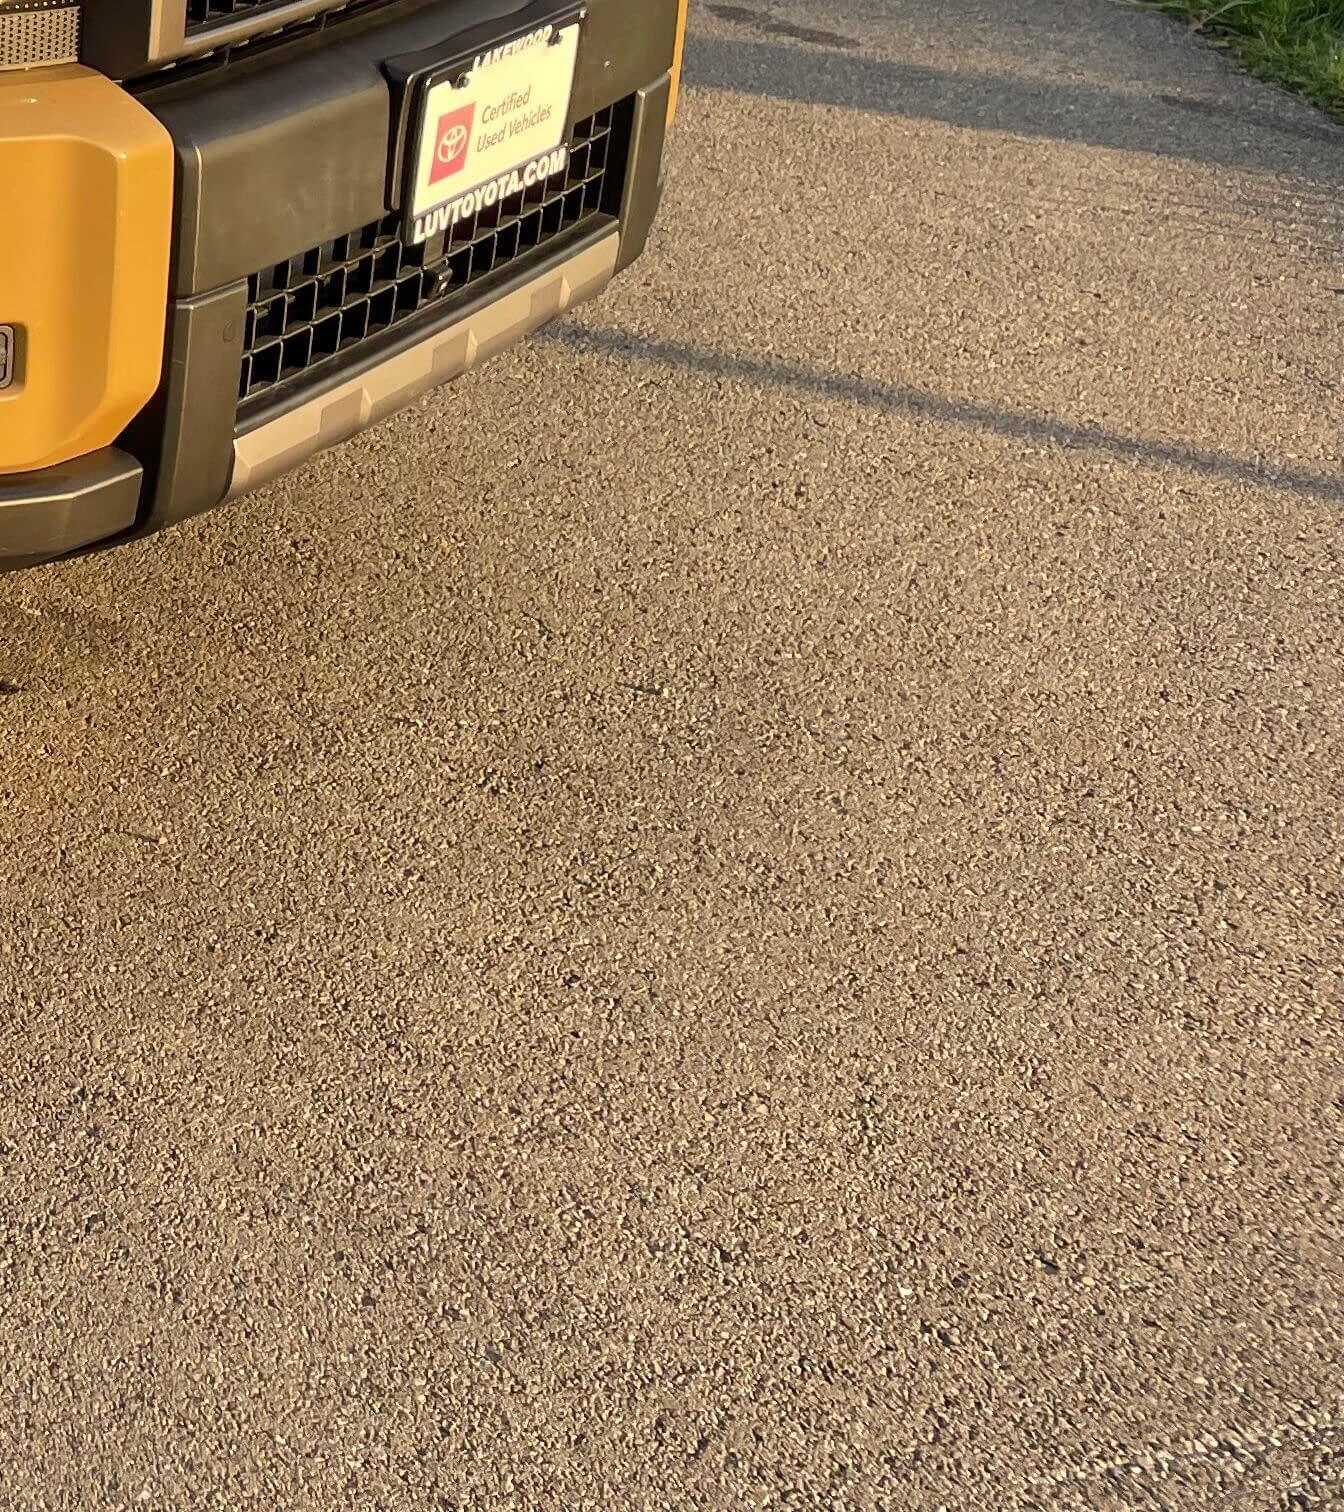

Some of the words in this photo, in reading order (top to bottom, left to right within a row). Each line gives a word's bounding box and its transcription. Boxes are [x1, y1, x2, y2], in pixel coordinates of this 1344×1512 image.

[476, 128, 507, 153] Used
[508, 103, 552, 138] Vehicles
[481, 85, 531, 124] Certified
[413, 147, 568, 245] LUVTOYOTA.COM
